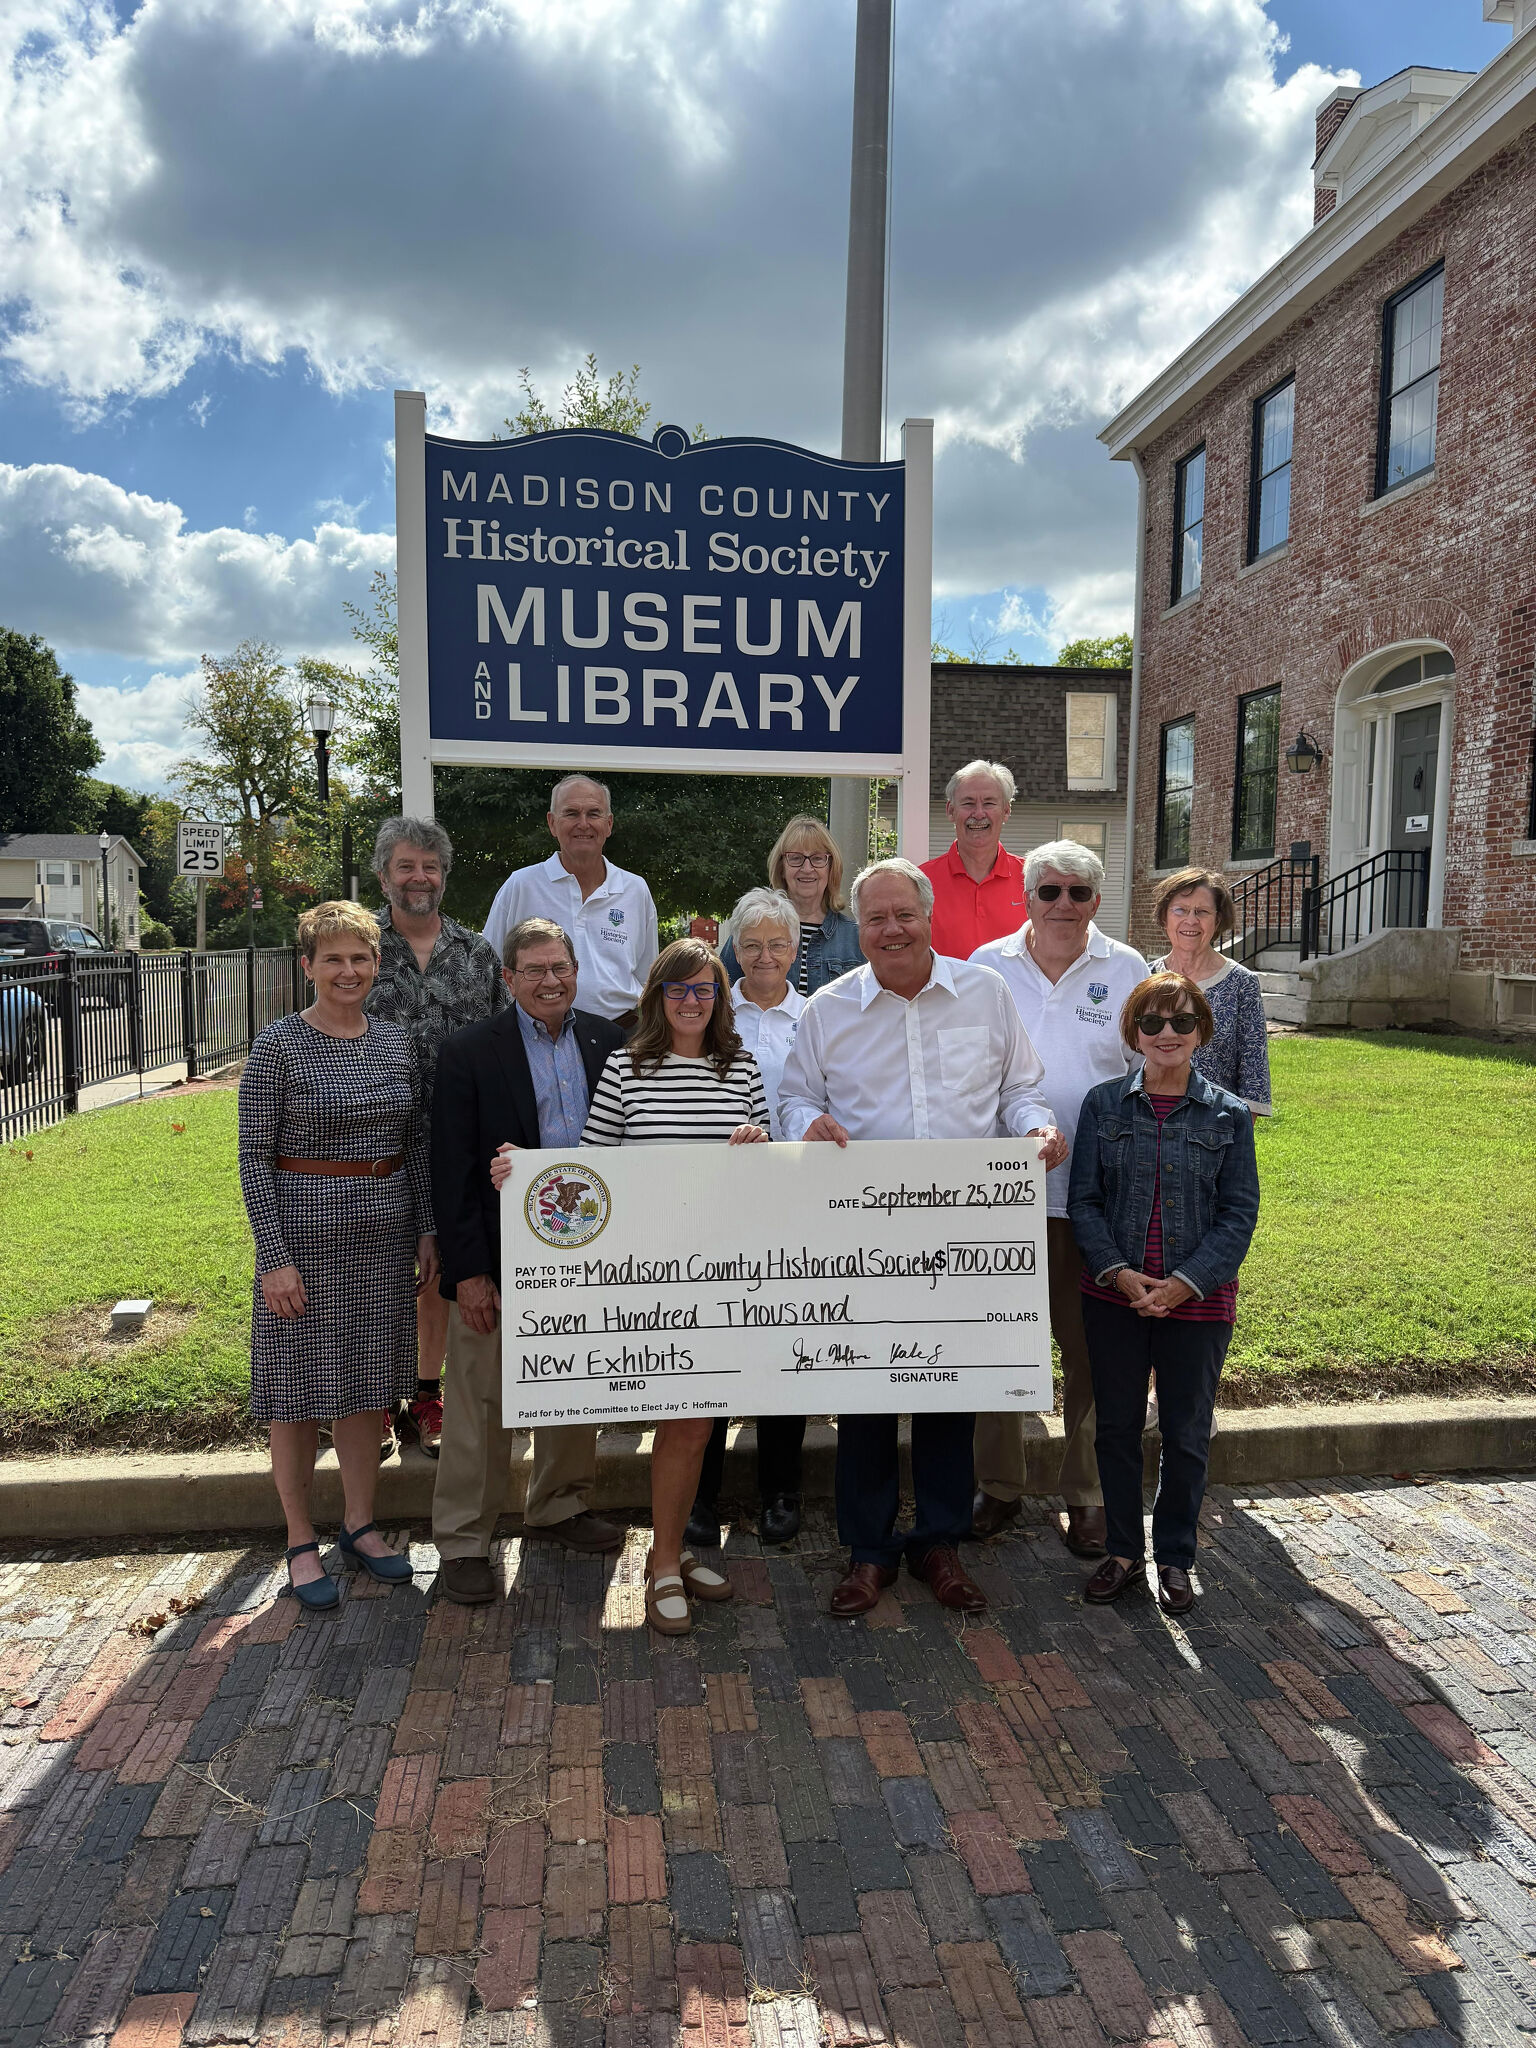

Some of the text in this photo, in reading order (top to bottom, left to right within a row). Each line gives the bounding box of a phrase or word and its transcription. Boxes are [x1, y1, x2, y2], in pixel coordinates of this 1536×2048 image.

[442, 470, 892, 523] MADISON COUNTY
[443, 517, 891, 589] Historical Society
[477, 583, 862, 660] MUSEUM
[475, 661, 491, 720] AND
[508, 662, 861, 733] LIBRARY
[182, 827, 220, 838] SPEED
[186, 839, 216, 849] LIMIT
[183, 850, 219, 870] 25
[1075, 1008, 1112, 1021] Historical
[1079, 1014, 1106, 1027] Society
[986, 1161, 1029, 1171] 10001
[540, 1171, 553, 1184] THE
[553, 1167, 577, 1175] STATE
[577, 1169, 588, 1177] OF
[829, 1199, 860, 1209] DATE
[862, 1183, 962, 1216] September
[584, 1246, 938, 1292] Madison County Historical Society
[949, 1246, 1035, 1275] 700,000
[515, 1265, 582, 1277] PAY TO THE
[515, 1277, 577, 1290] ORDER OF
[518, 1294, 854, 1336] Seven Hundred Thousand
[986, 1312, 1039, 1323] DOLLARS
[522, 1343, 694, 1379] New Exhibits
[609, 1380, 646, 1392] MEMO
[890, 1372, 959, 1383] SIGNATURE
[518, 1400, 728, 1419] Paid for by the Committee to Elect Jay C Hoffman
